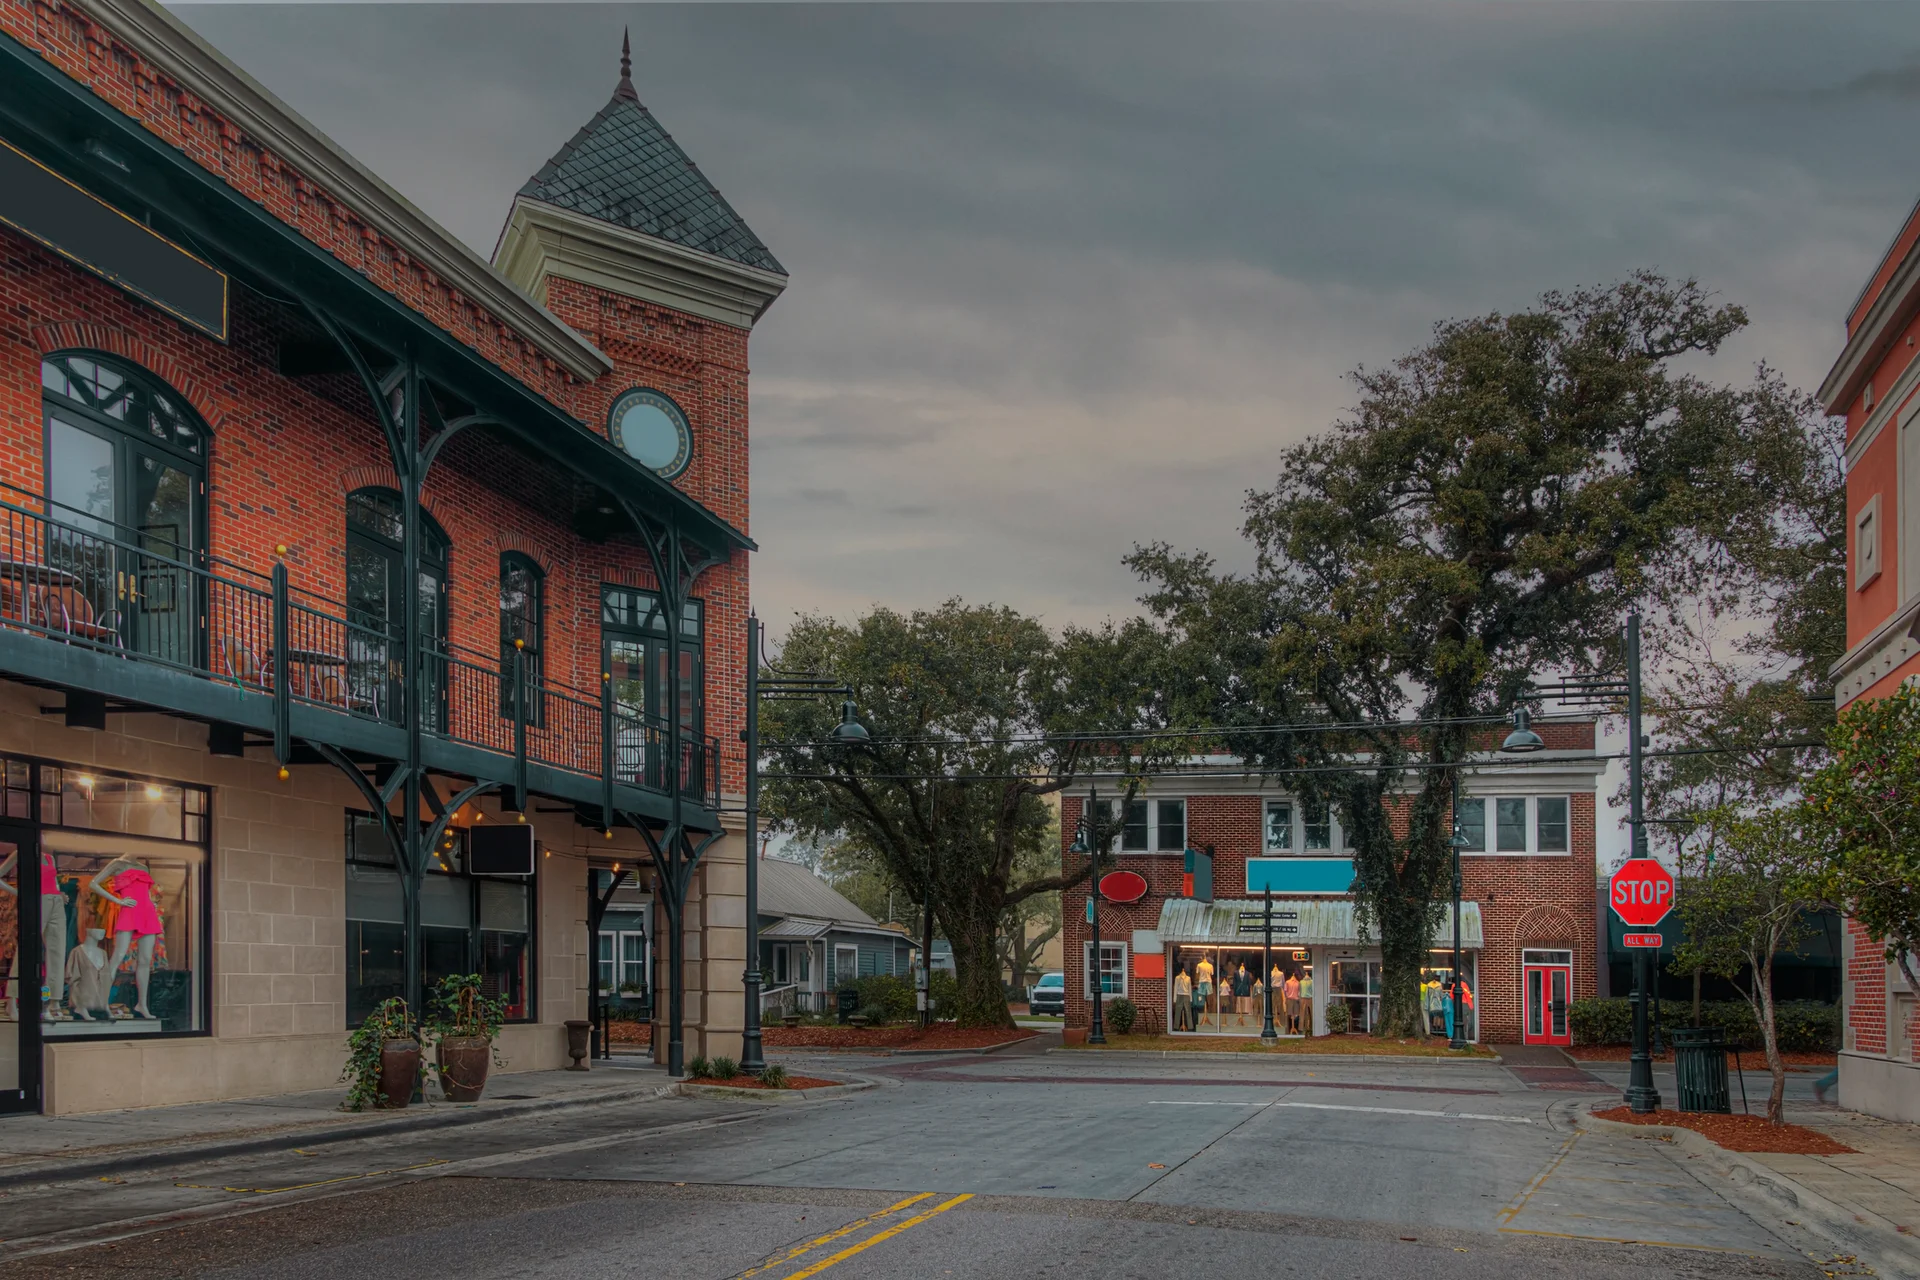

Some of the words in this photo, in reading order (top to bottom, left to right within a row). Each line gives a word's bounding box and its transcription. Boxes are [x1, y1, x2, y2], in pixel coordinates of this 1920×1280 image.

[1615, 880, 1670, 904] STOP
[1627, 937, 1640, 945] ALL
[1644, 937, 1659, 945] WAY
